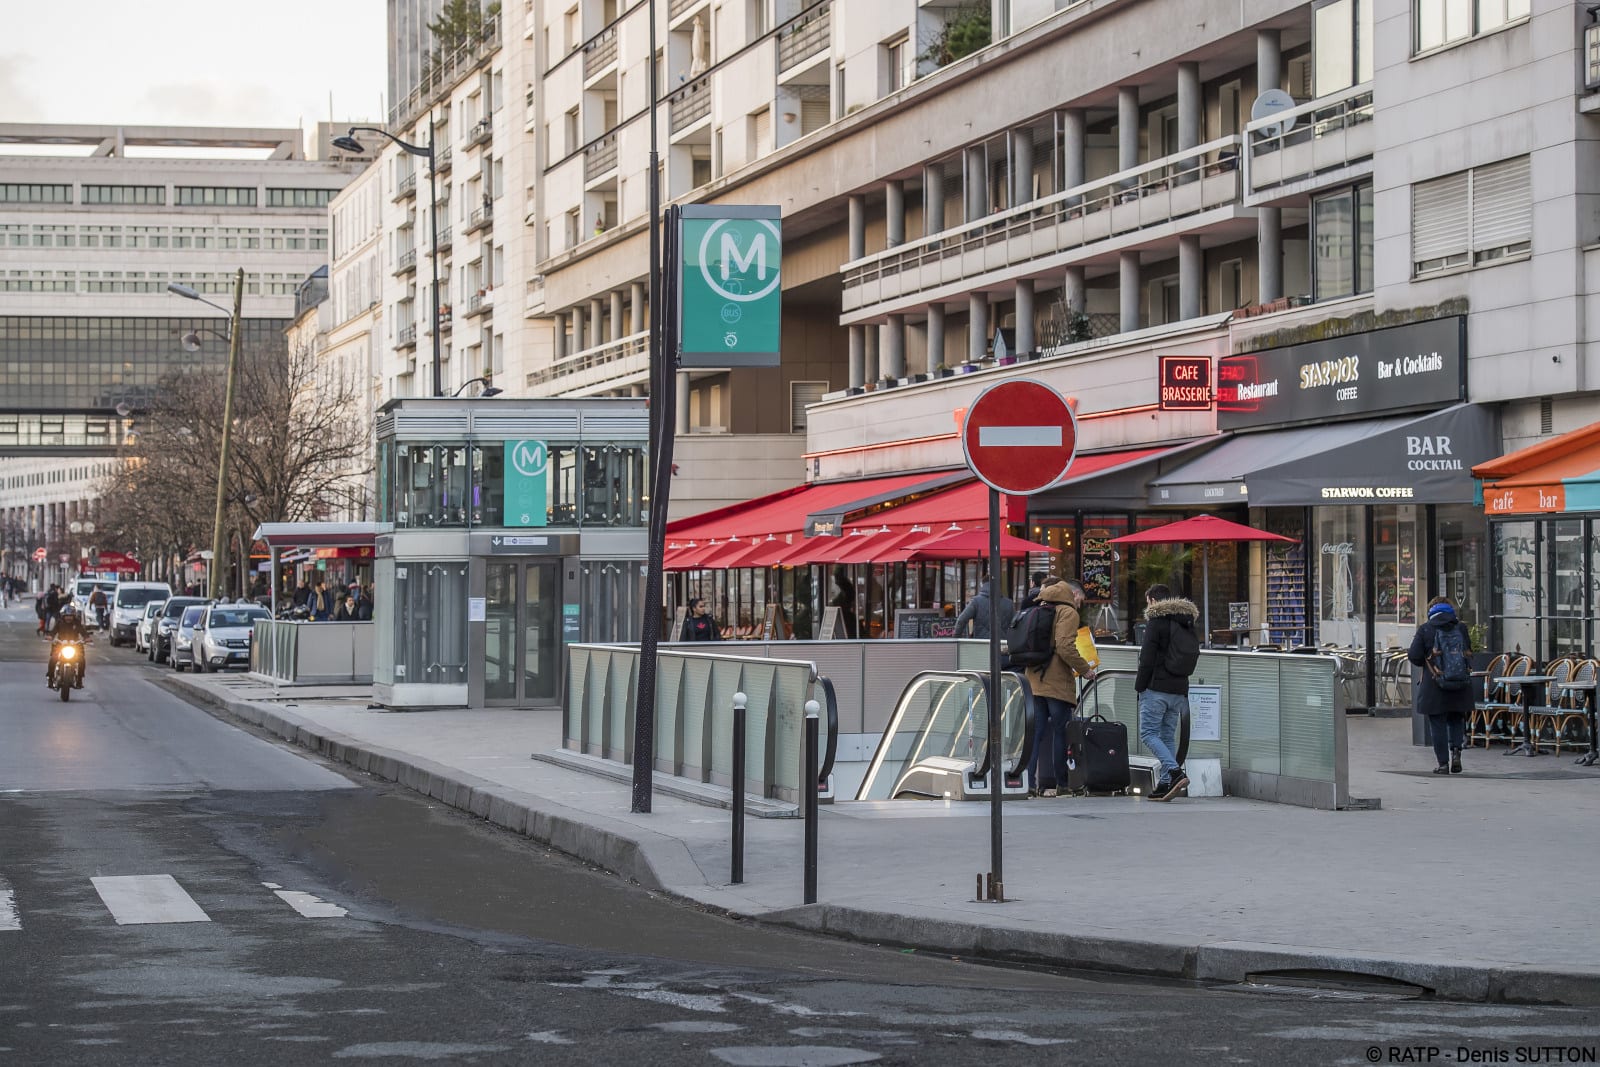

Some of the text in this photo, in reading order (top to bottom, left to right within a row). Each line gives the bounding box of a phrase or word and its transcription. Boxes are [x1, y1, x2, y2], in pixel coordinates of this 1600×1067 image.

[721, 232, 766, 281] M
[1174, 365, 1199, 380] CAFE
[1300, 354, 1360, 389] STARWOK
[1377, 351, 1443, 379] Bar & Cocktails
[1162, 386, 1211, 401] BRASSERIE
[1237, 378, 1279, 401] Restaurant
[1336, 386, 1358, 401] COFFEE
[1406, 436, 1453, 456] BAR
[521, 446, 542, 468] M
[1407, 459, 1464, 471] COCKTAIL
[1321, 487, 1414, 498] STARWOK COFFEE
[1493, 489, 1558, 511] café bar
